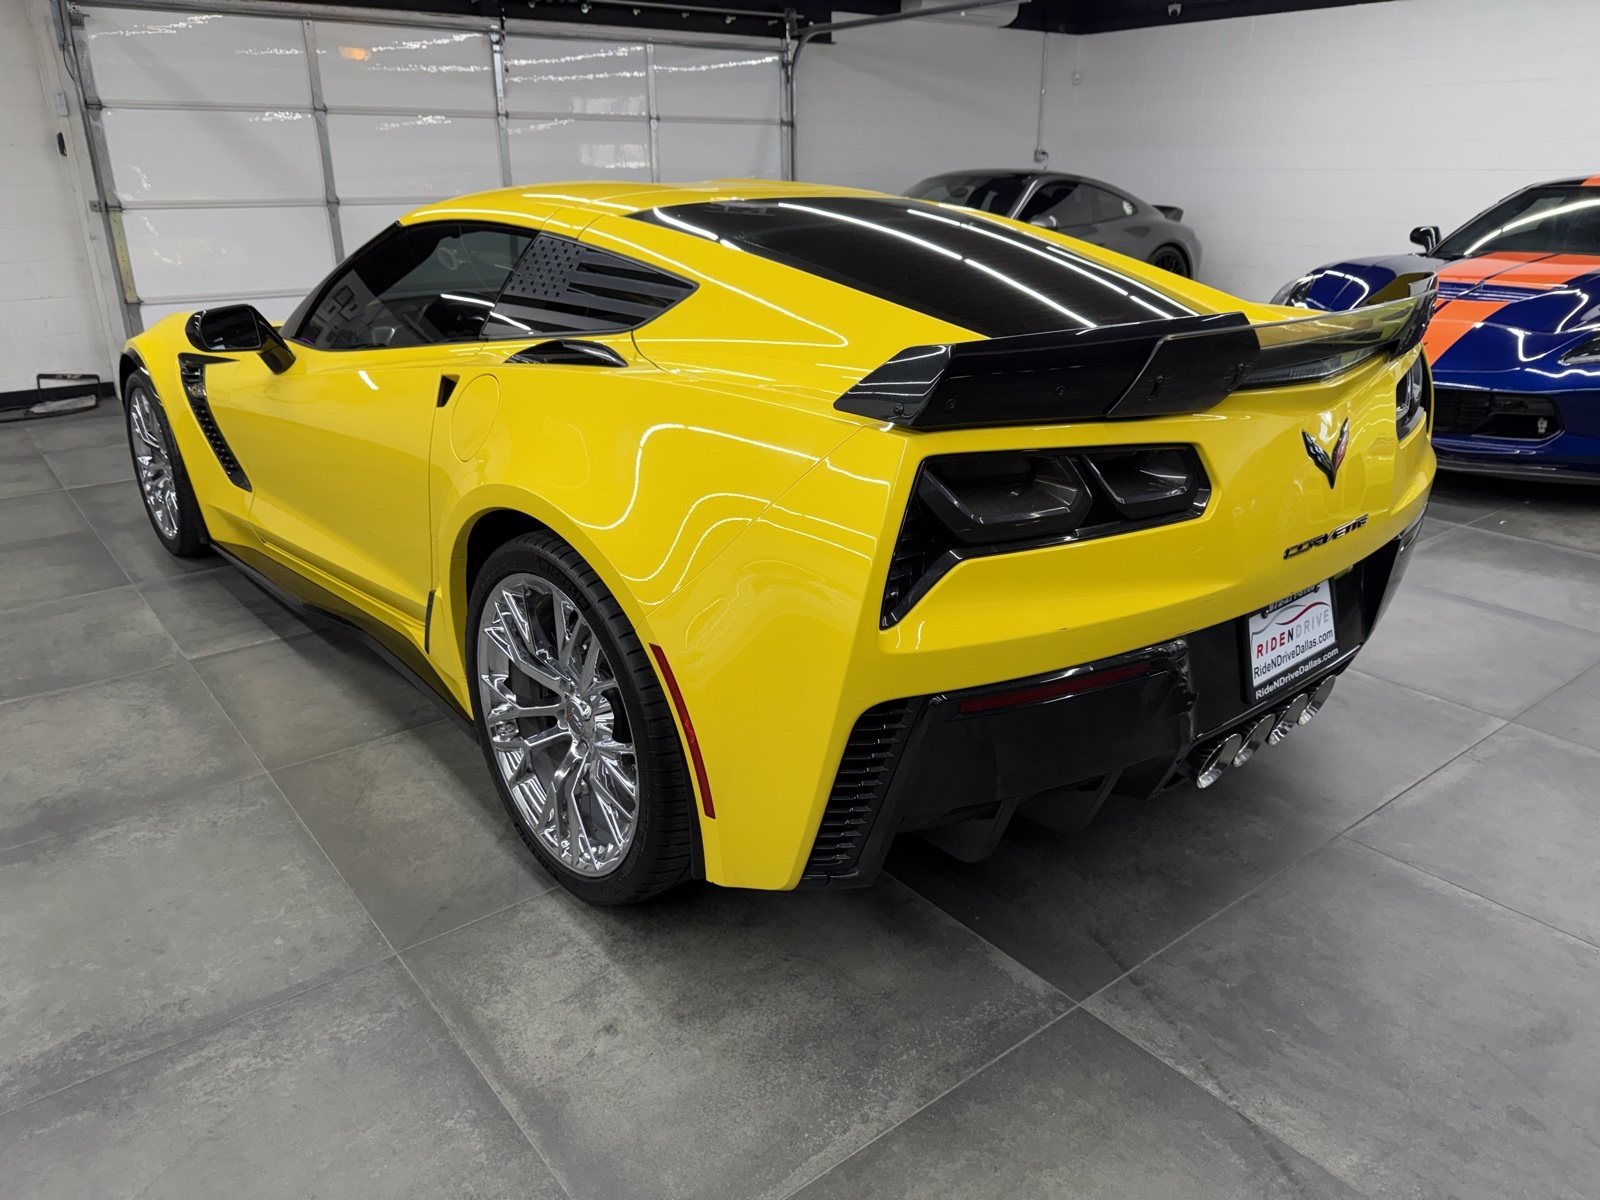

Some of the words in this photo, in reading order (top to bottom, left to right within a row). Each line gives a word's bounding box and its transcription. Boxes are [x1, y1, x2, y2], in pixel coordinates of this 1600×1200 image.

[1283, 514, 1369, 559] CORVETTE
[1253, 629, 1333, 680] RideNDriveDallas.com
[1255, 647, 1339, 699] RideNDriveDallas.com
